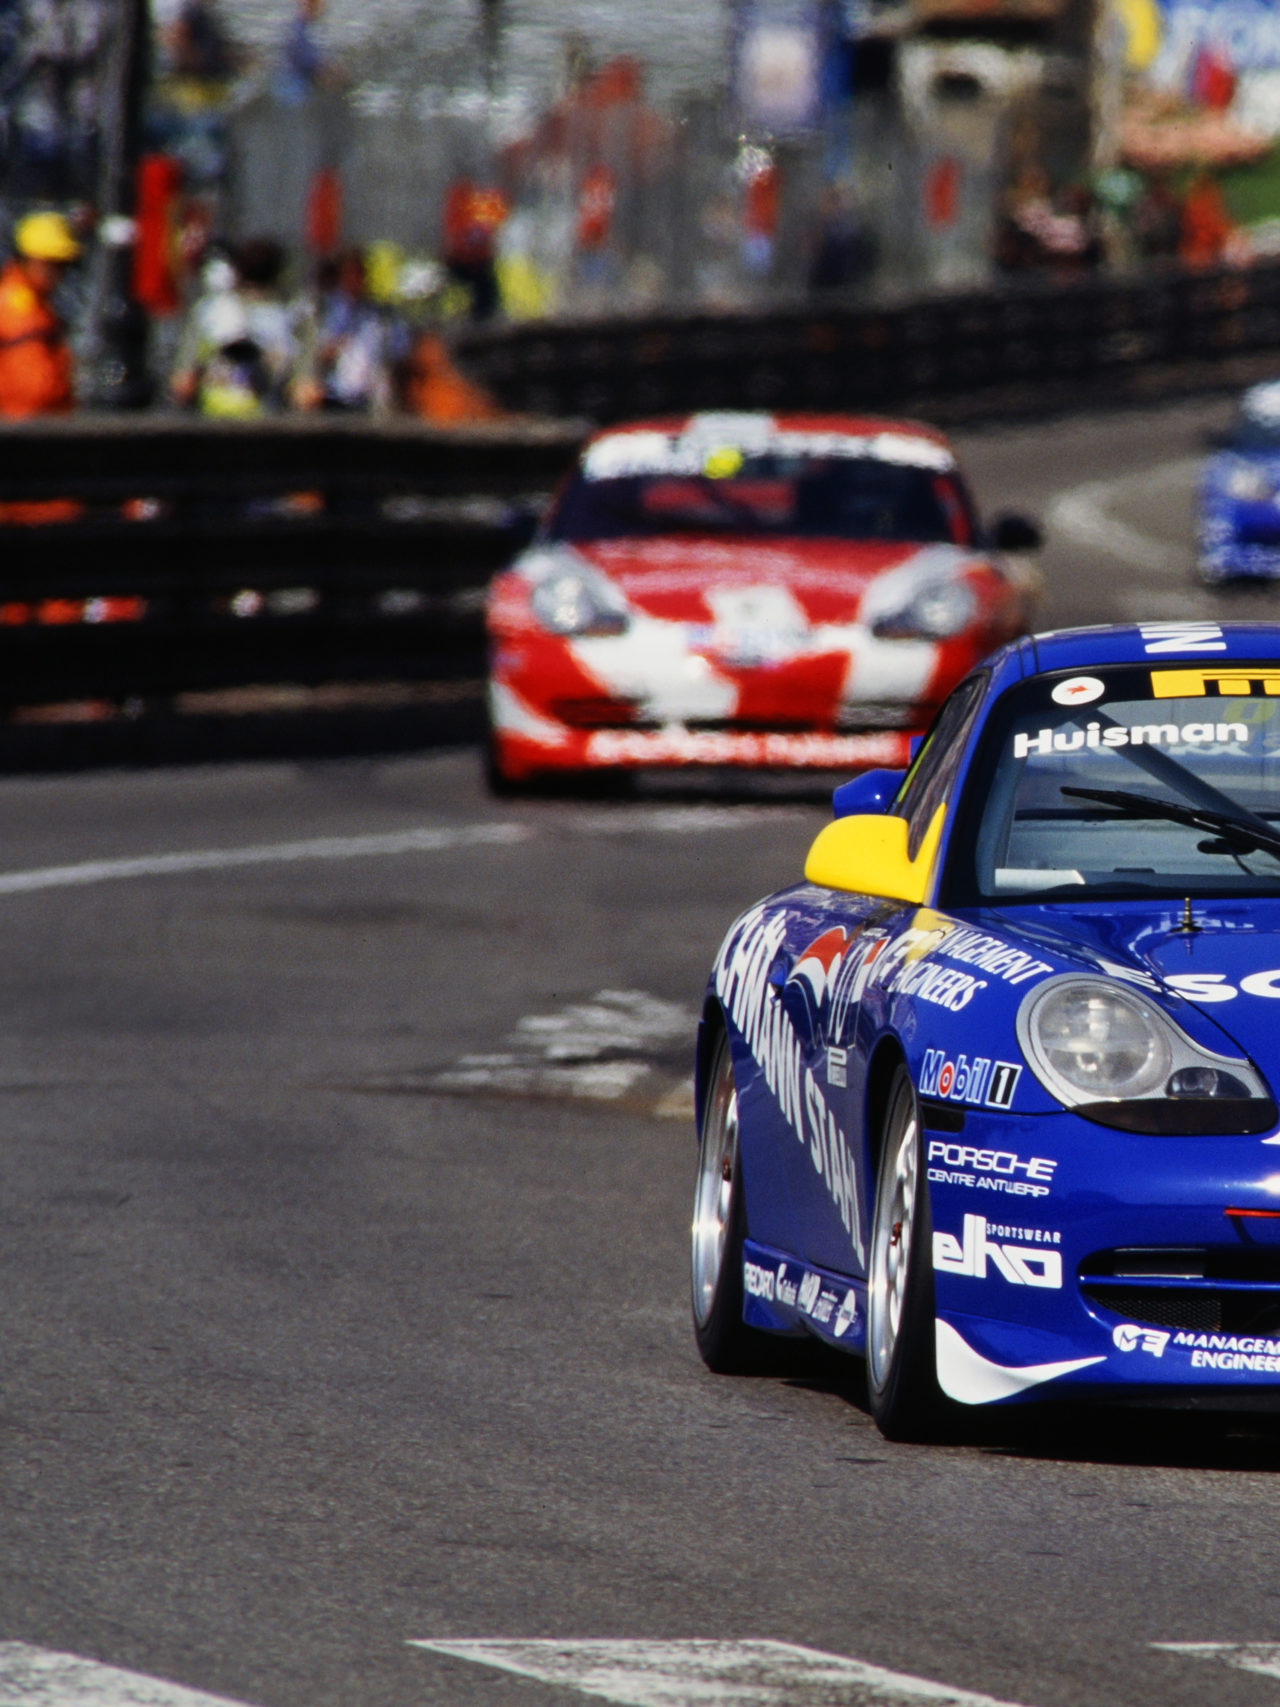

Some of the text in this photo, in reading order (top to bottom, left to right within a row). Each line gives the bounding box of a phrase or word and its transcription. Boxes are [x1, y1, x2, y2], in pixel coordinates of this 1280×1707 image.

[1013, 721, 1249, 759] Huisman
[918, 1048, 991, 1104] Mobil
[927, 1140, 1058, 1182] PORSCHE
[926, 1167, 1050, 1198] CENTRE ANTWERP
[985, 1222, 1062, 1244] SPORTSWEAR
